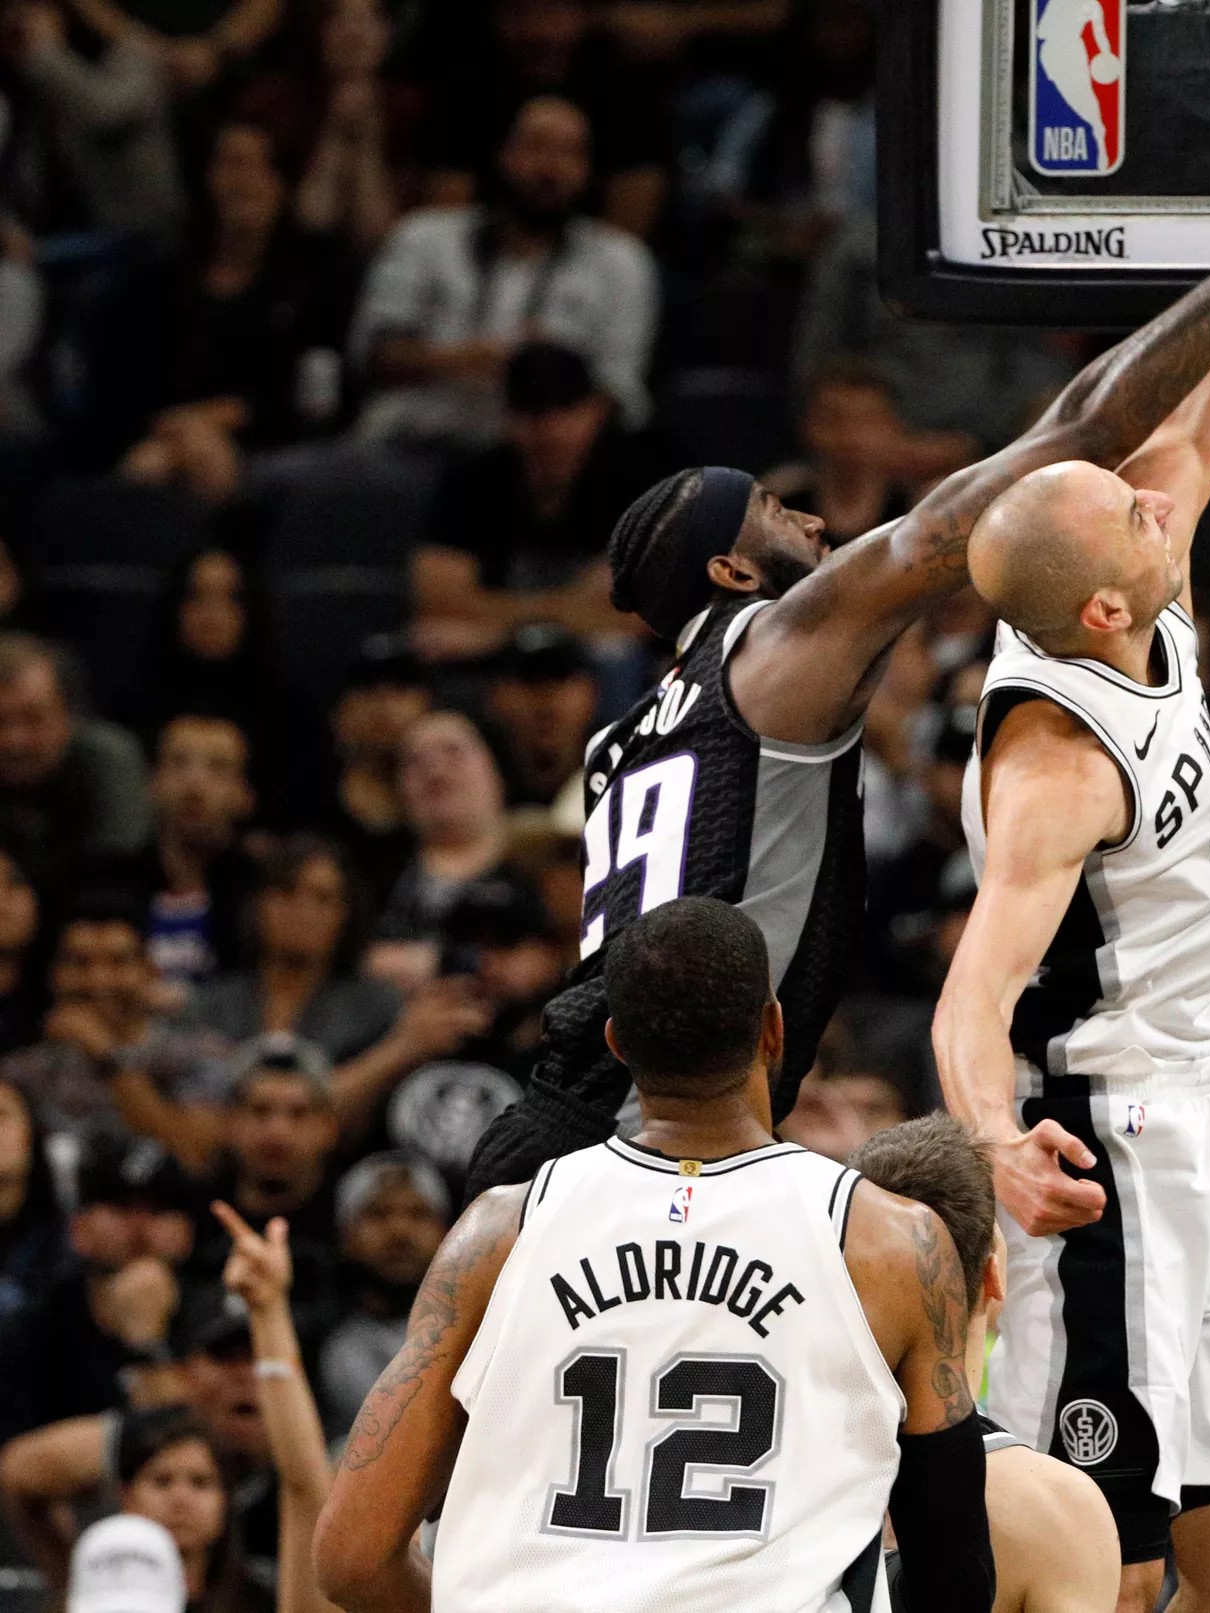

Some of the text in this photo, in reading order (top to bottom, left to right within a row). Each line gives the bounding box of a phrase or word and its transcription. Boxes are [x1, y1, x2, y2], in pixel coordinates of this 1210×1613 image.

[1043, 127, 1088, 161] NBA
[981, 226, 1124, 259] SPALDING
[549, 1240, 807, 1339] ALDRIDGE
[539, 1346, 787, 1542] 12
